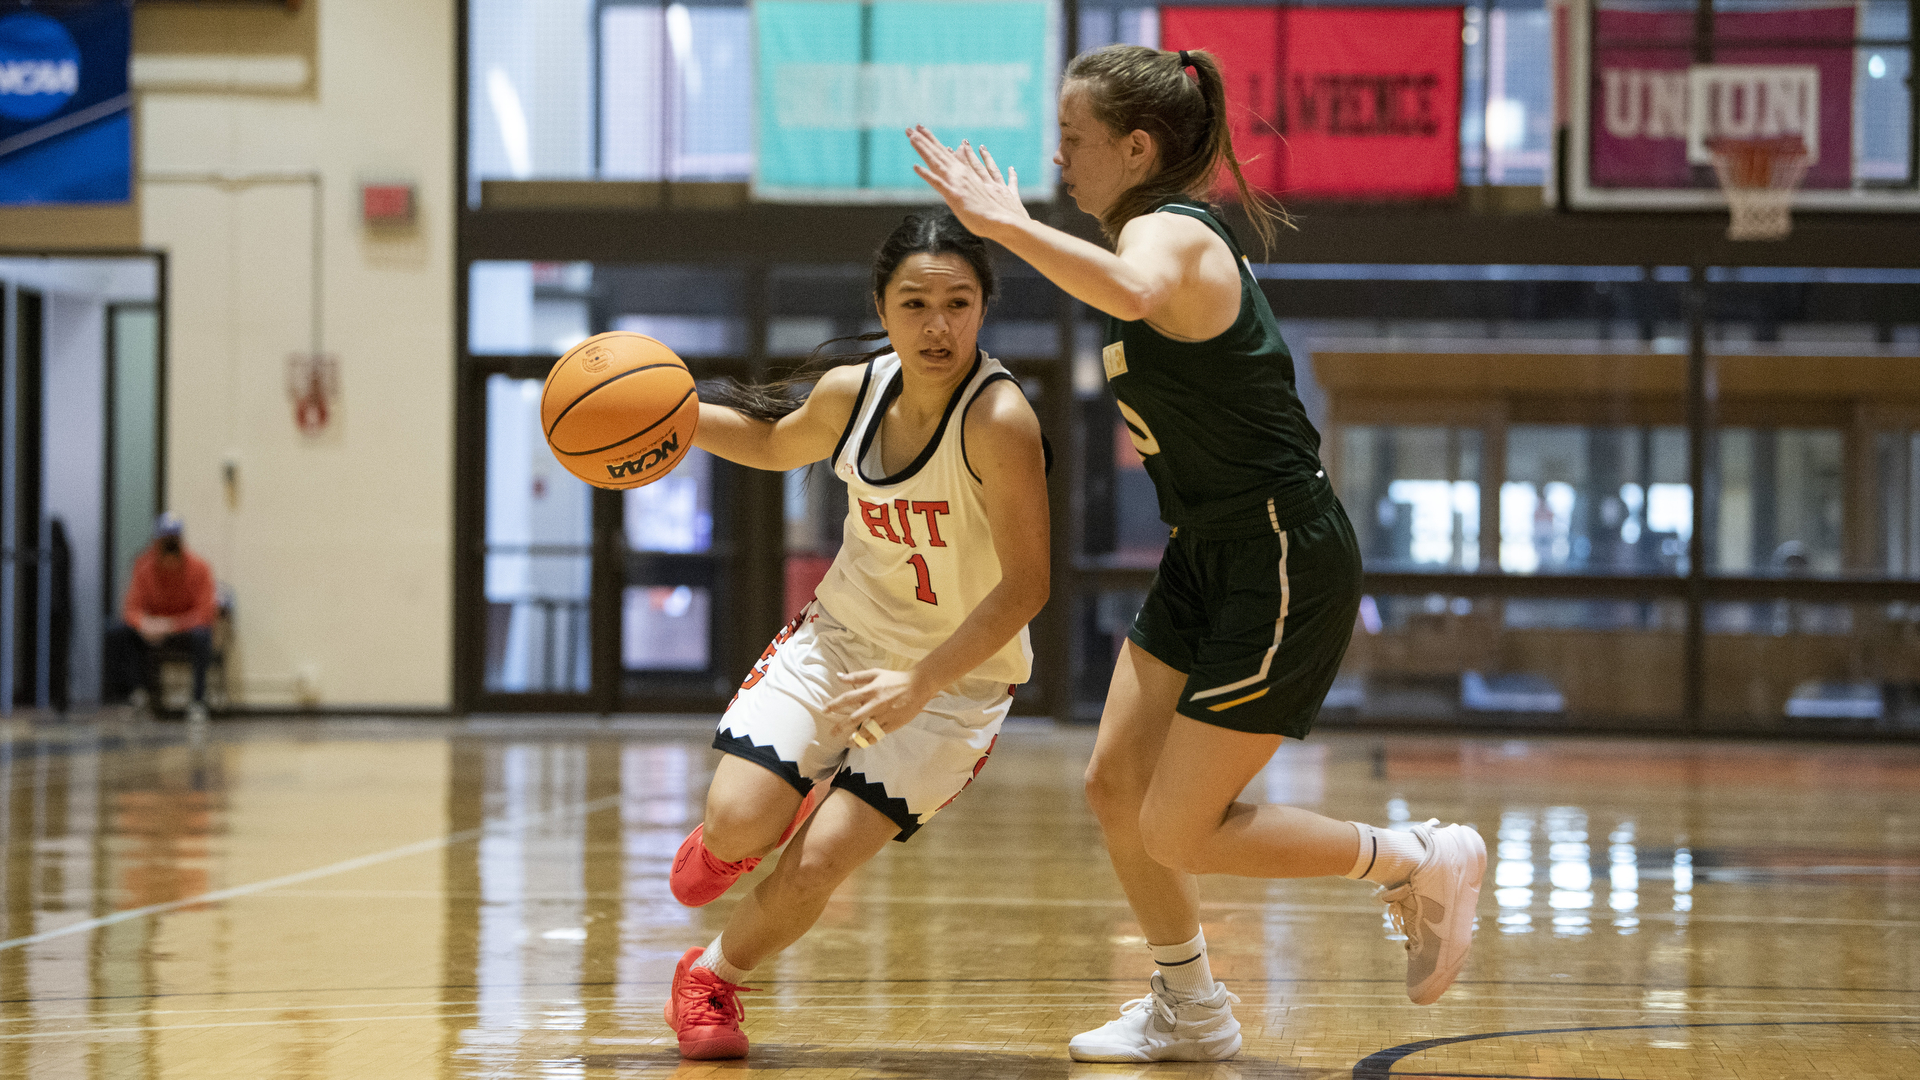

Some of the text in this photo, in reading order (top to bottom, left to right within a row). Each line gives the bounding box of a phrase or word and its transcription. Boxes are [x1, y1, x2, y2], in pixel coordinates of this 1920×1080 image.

[1604, 68, 1808, 139] UNON
[606, 432, 679, 479] NCAA
[858, 498, 950, 548] RIT
[906, 554, 938, 606] 1
